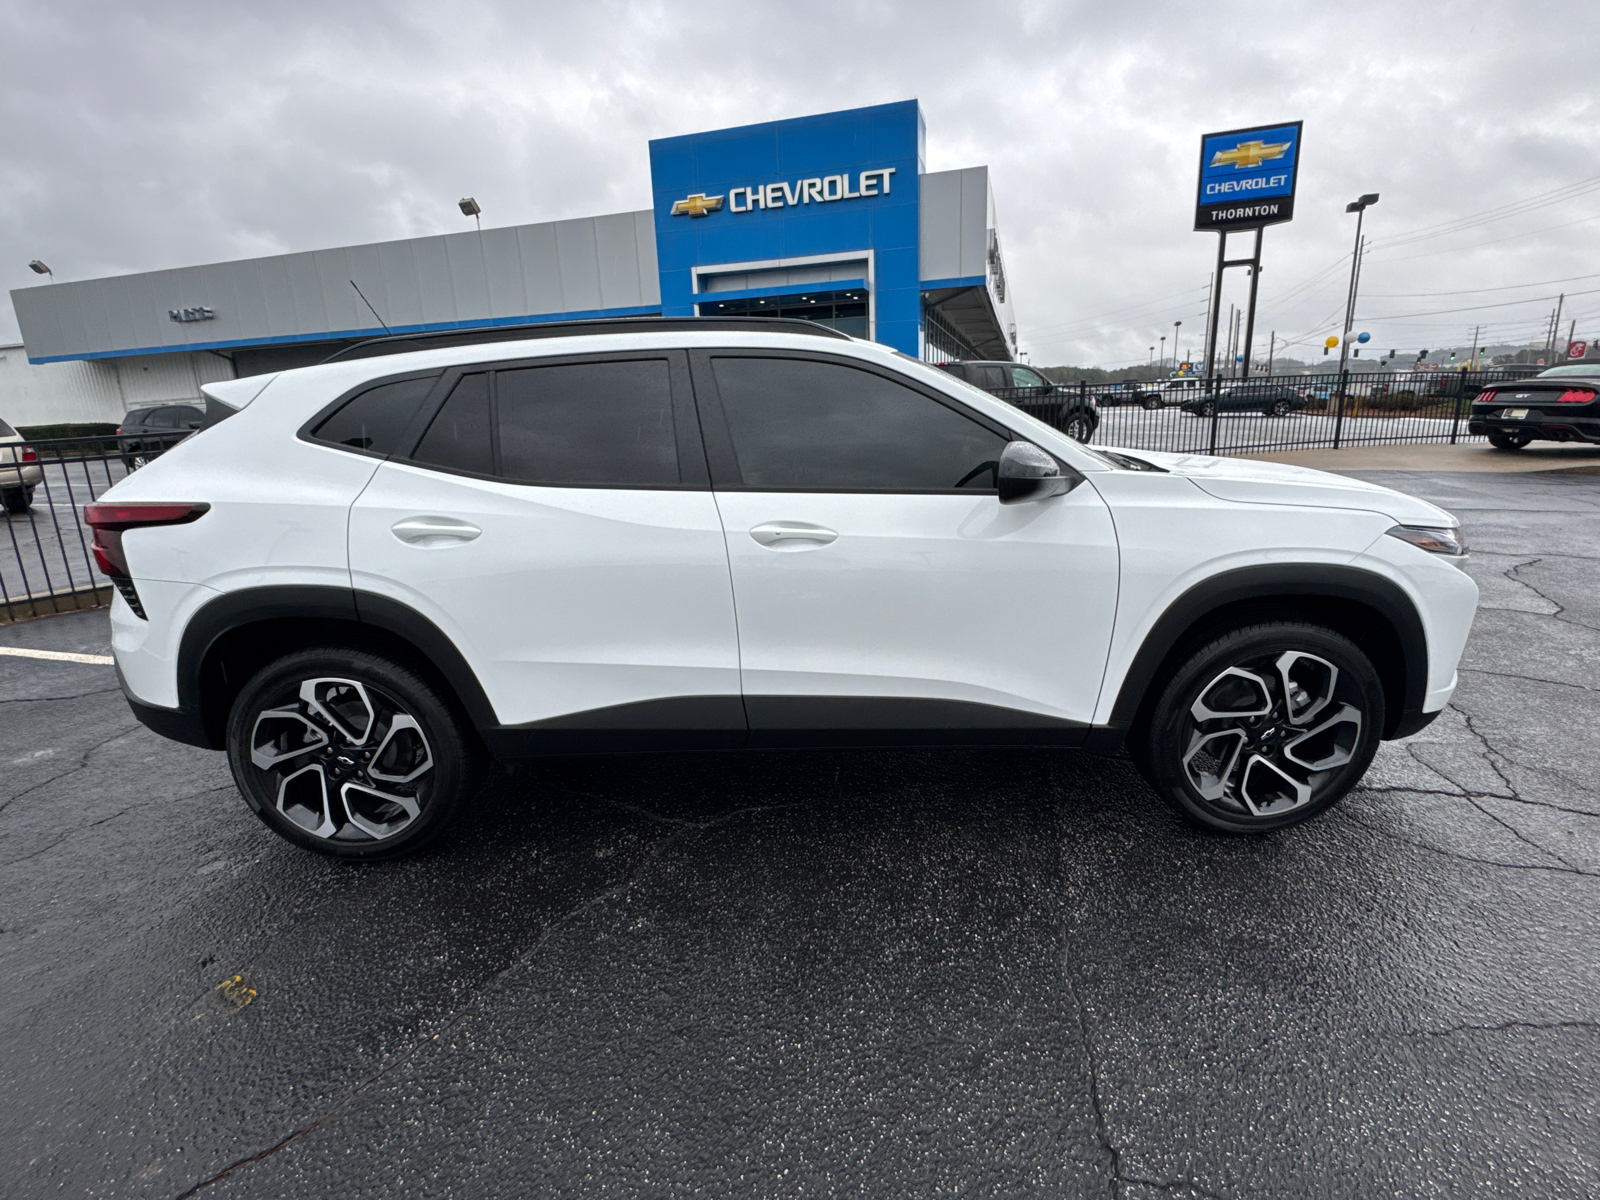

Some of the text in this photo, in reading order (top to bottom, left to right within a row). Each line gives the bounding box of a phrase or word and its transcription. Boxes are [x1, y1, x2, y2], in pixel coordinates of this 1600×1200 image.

[729, 167, 896, 213] CHEVROLET
[1206, 174, 1288, 195] CHEVROLET
[1211, 204, 1279, 221] THORNTON
